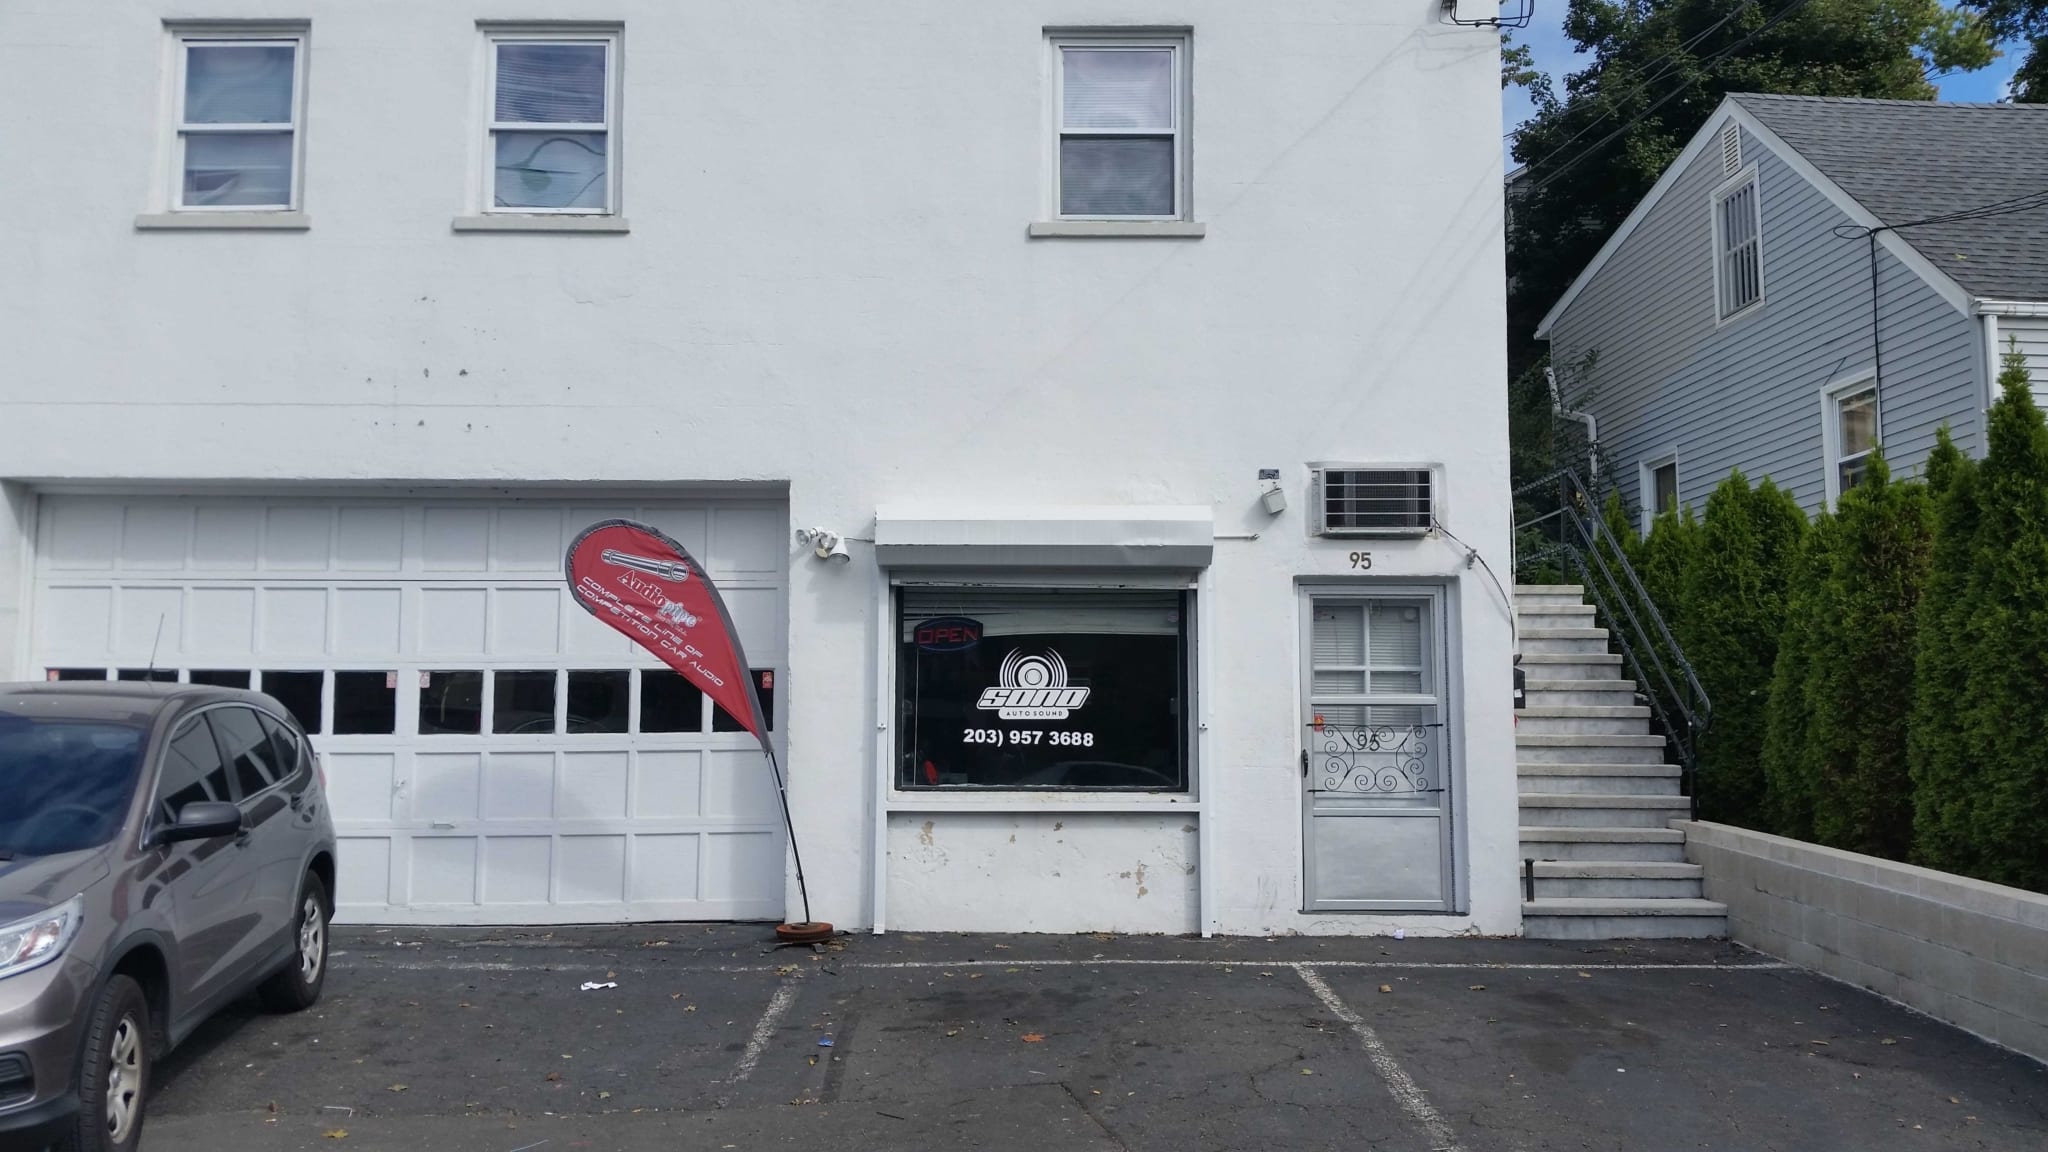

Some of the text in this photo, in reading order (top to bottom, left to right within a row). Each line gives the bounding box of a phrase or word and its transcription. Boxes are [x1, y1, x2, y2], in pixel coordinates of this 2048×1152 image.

[1349, 551, 1372, 570] 95
[582, 576, 652, 624] COMPLETE
[684, 644, 704, 658] OF
[576, 584, 659, 640] COMPETITION
[660, 639, 688, 659] CAR
[689, 660, 724, 687] AUDIO
[918, 627, 978, 645] OPEN
[963, 728, 1094, 748] 203) 957 3688
